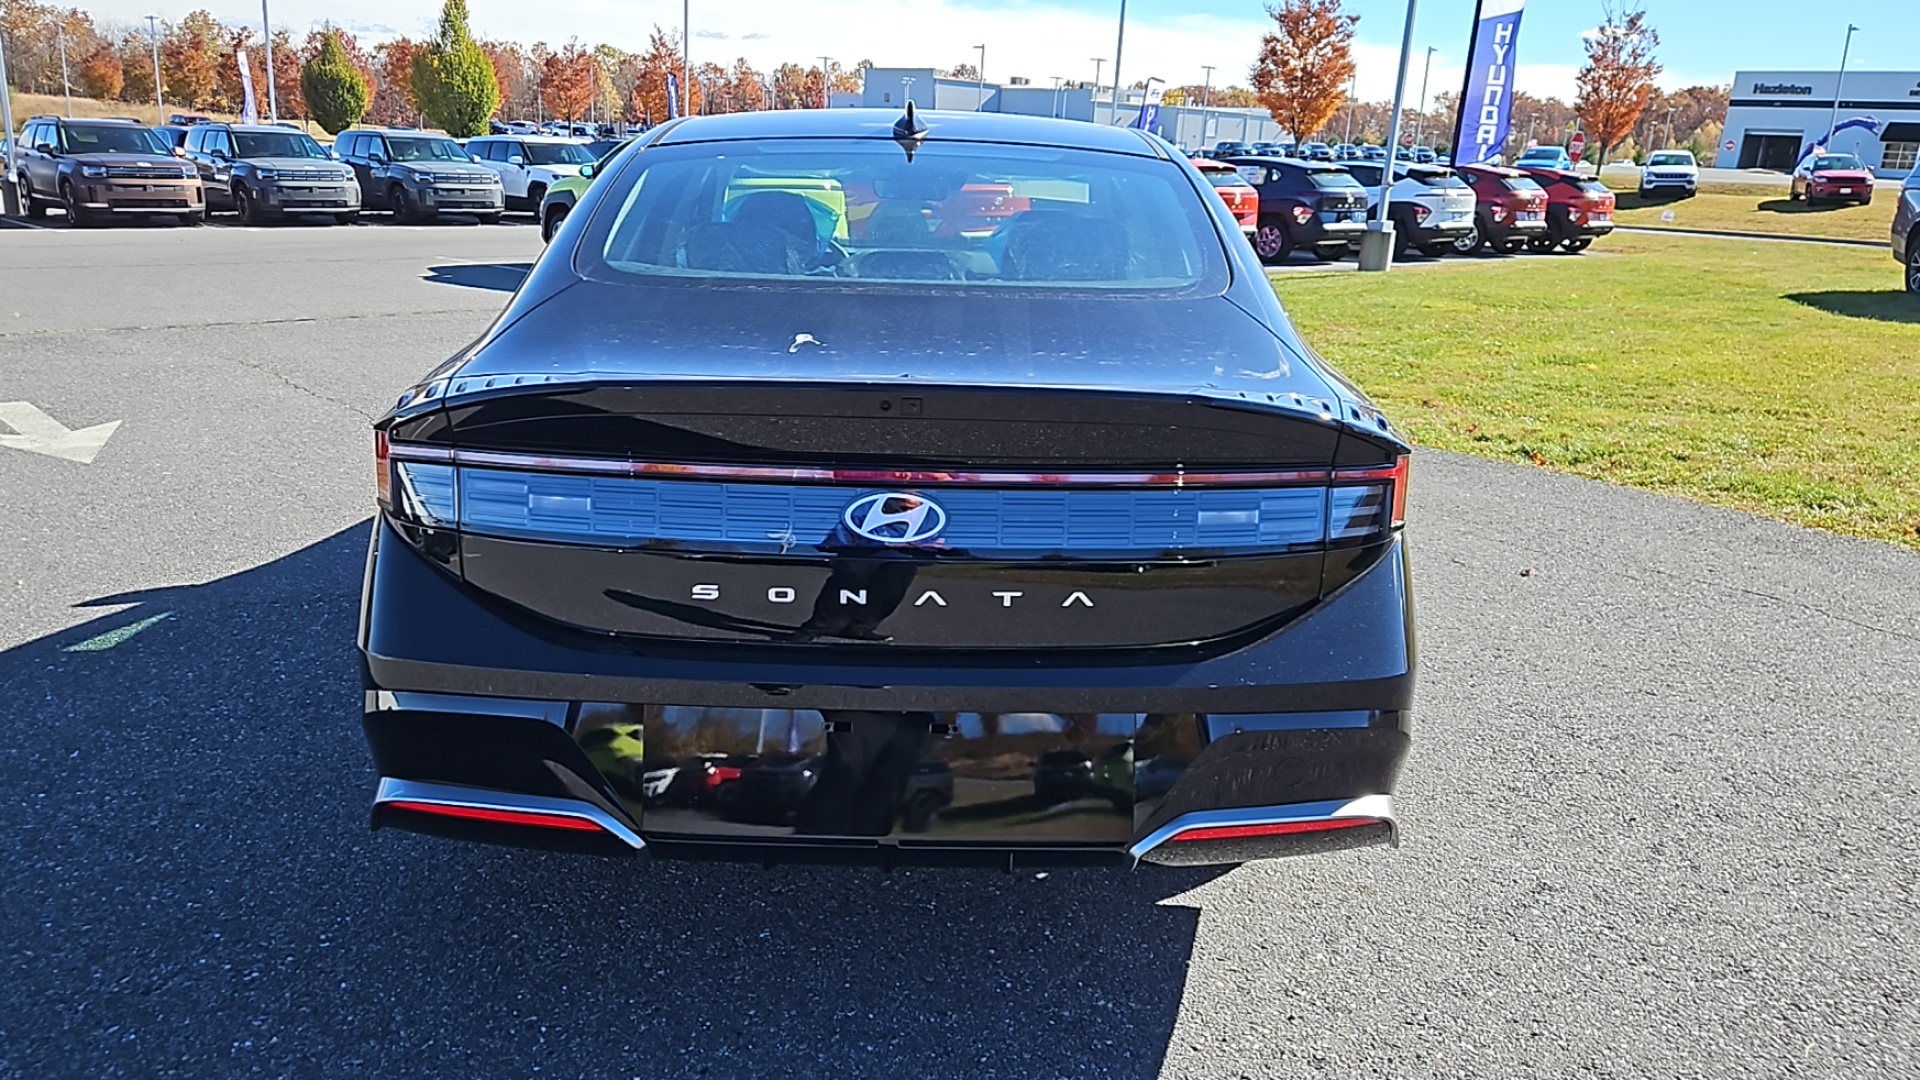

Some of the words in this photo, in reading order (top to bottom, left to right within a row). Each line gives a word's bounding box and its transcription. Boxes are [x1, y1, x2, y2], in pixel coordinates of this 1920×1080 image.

[1475, 23, 1514, 162] HYUNDAI
[1753, 83, 1812, 95] Hazleton
[691, 584, 1094, 607] SONATA
